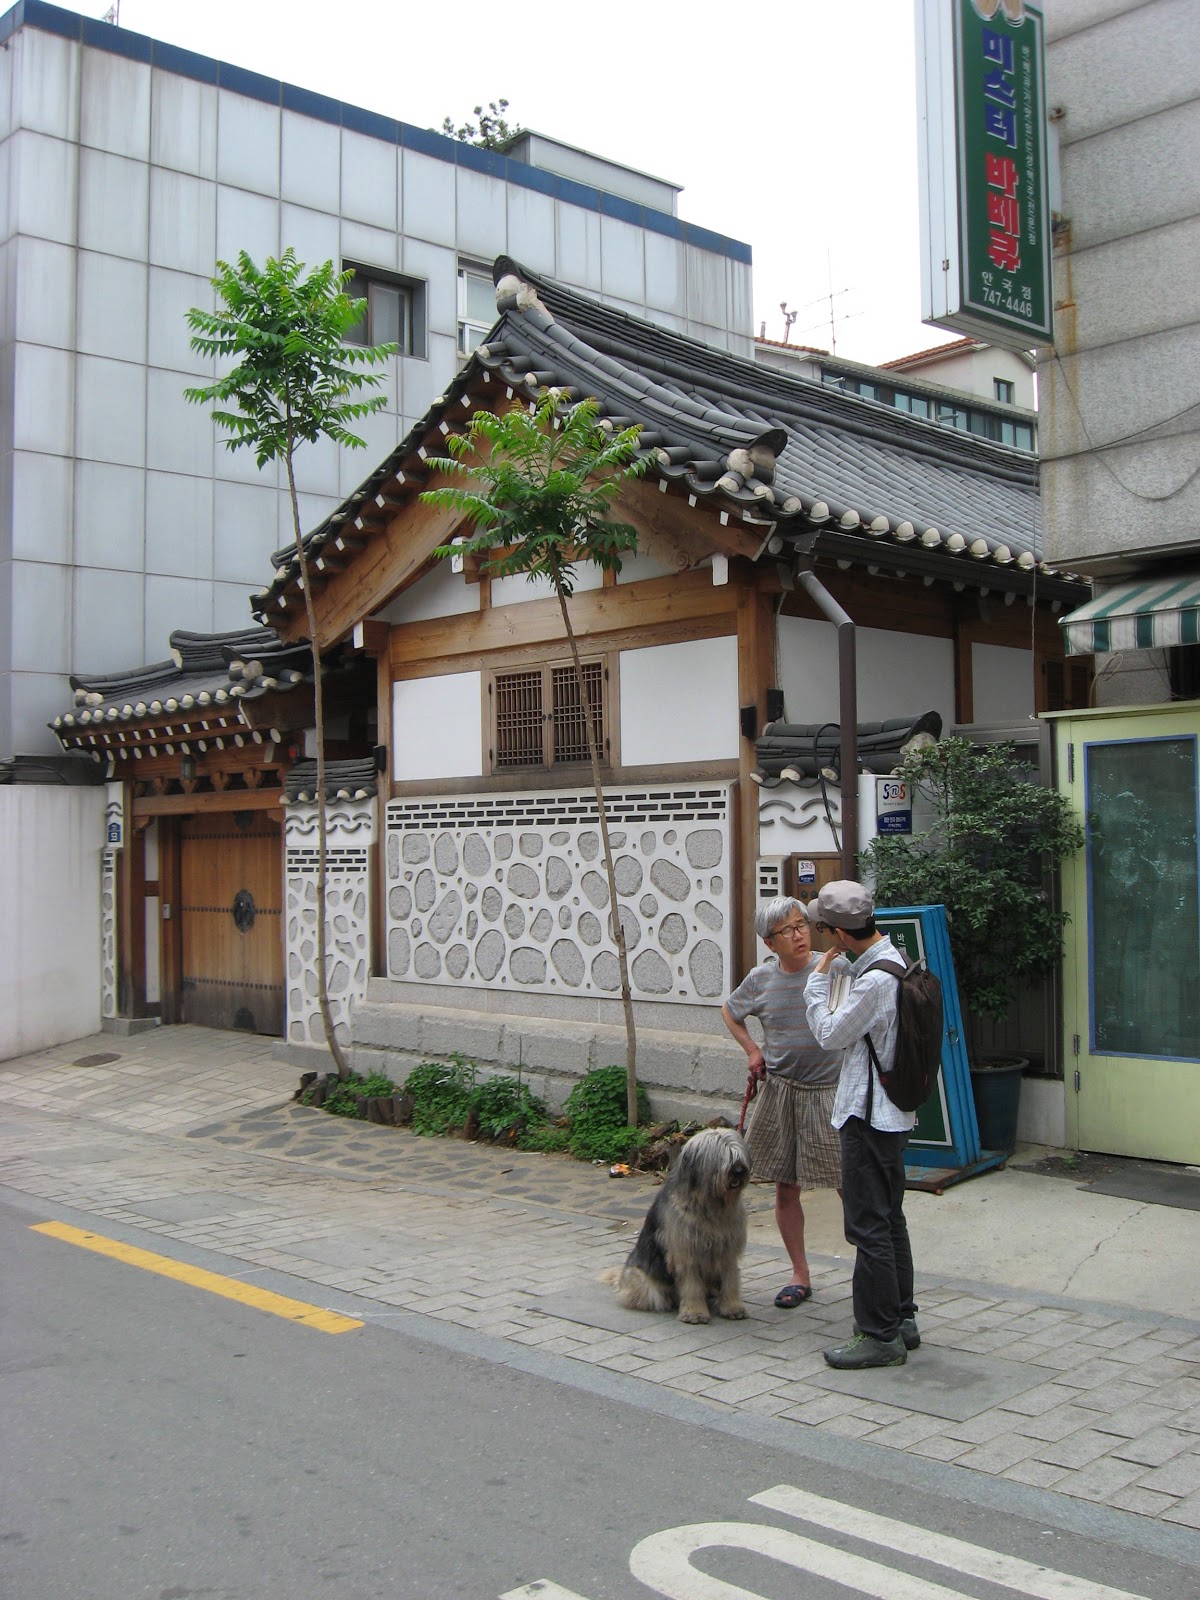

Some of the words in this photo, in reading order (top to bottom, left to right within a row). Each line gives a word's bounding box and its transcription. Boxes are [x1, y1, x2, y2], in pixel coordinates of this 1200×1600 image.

[983, 27, 1018, 149] 미스터
[985, 151, 1021, 275] 바베큐
[982, 287, 1033, 318] 747-4446
